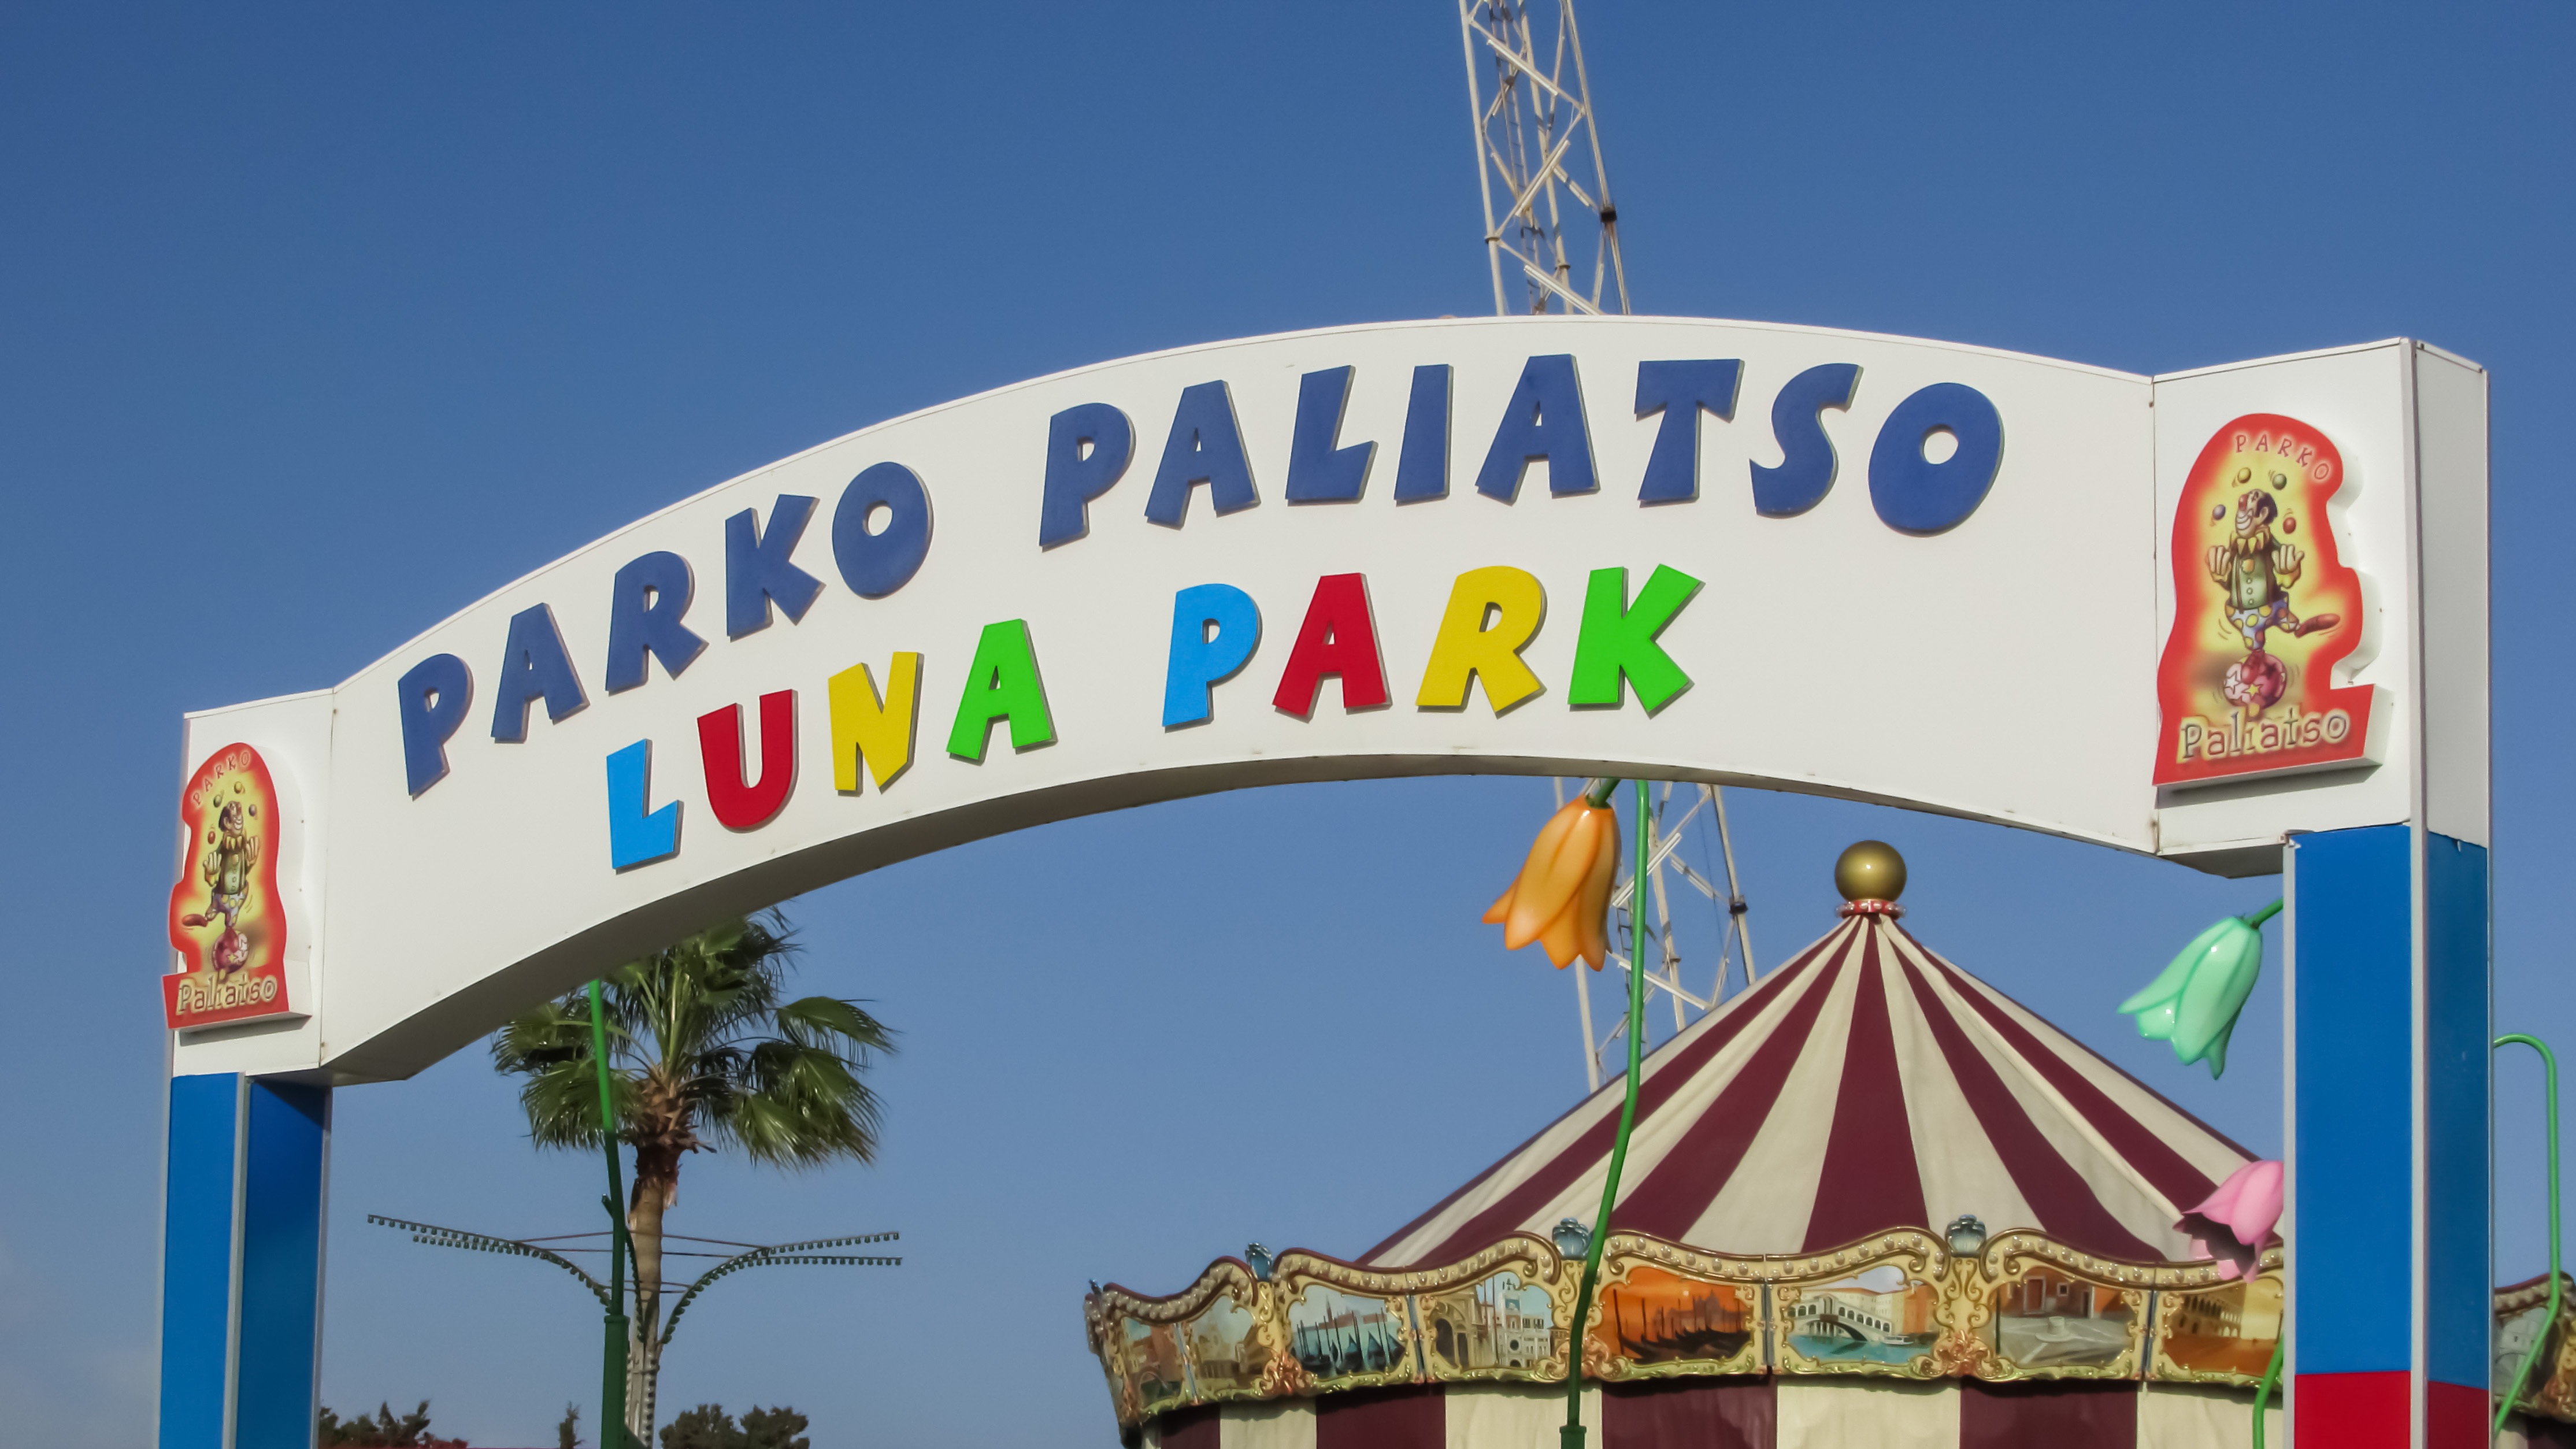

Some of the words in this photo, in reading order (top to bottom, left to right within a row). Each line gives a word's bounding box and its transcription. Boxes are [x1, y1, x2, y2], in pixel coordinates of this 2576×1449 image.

[2234, 433, 2333, 482] PARKO
[398, 462, 931, 796] PARKO
[1040, 354, 2003, 546] PALIATSO
[607, 618, 1055, 871] LUNA
[1162, 564, 1702, 728] PARK
[2181, 707, 2349, 759] Paliatso
[192, 751, 252, 807] PARKO
[177, 973, 277, 1013] Paliatso
